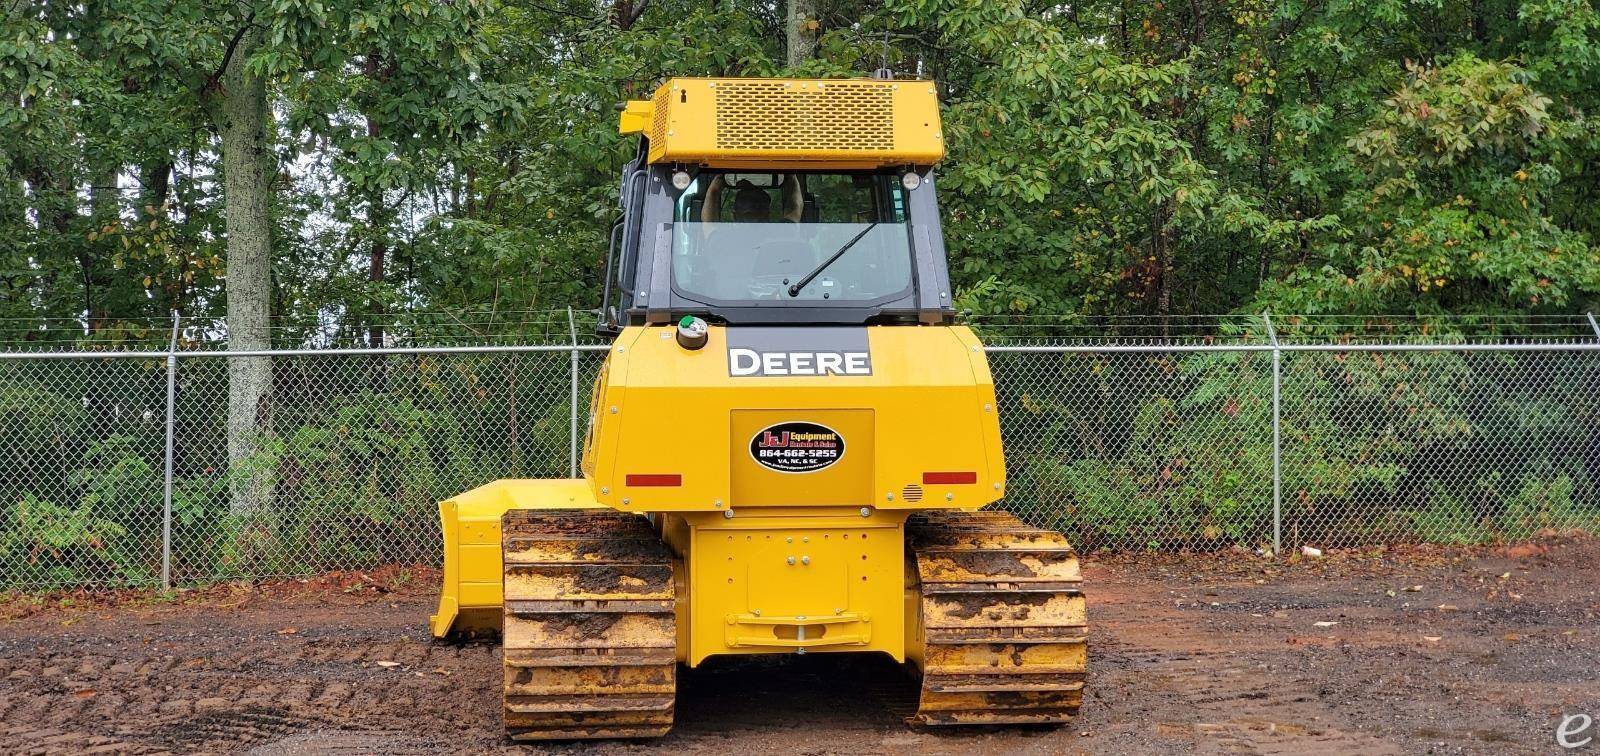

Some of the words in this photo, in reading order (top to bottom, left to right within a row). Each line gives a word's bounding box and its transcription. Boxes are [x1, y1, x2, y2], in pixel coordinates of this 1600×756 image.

[729, 348, 870, 376] DEERE
[759, 431, 790, 448] J&J
[790, 431, 837, 443] Equipment
[759, 449, 837, 458] 864-662-5255
